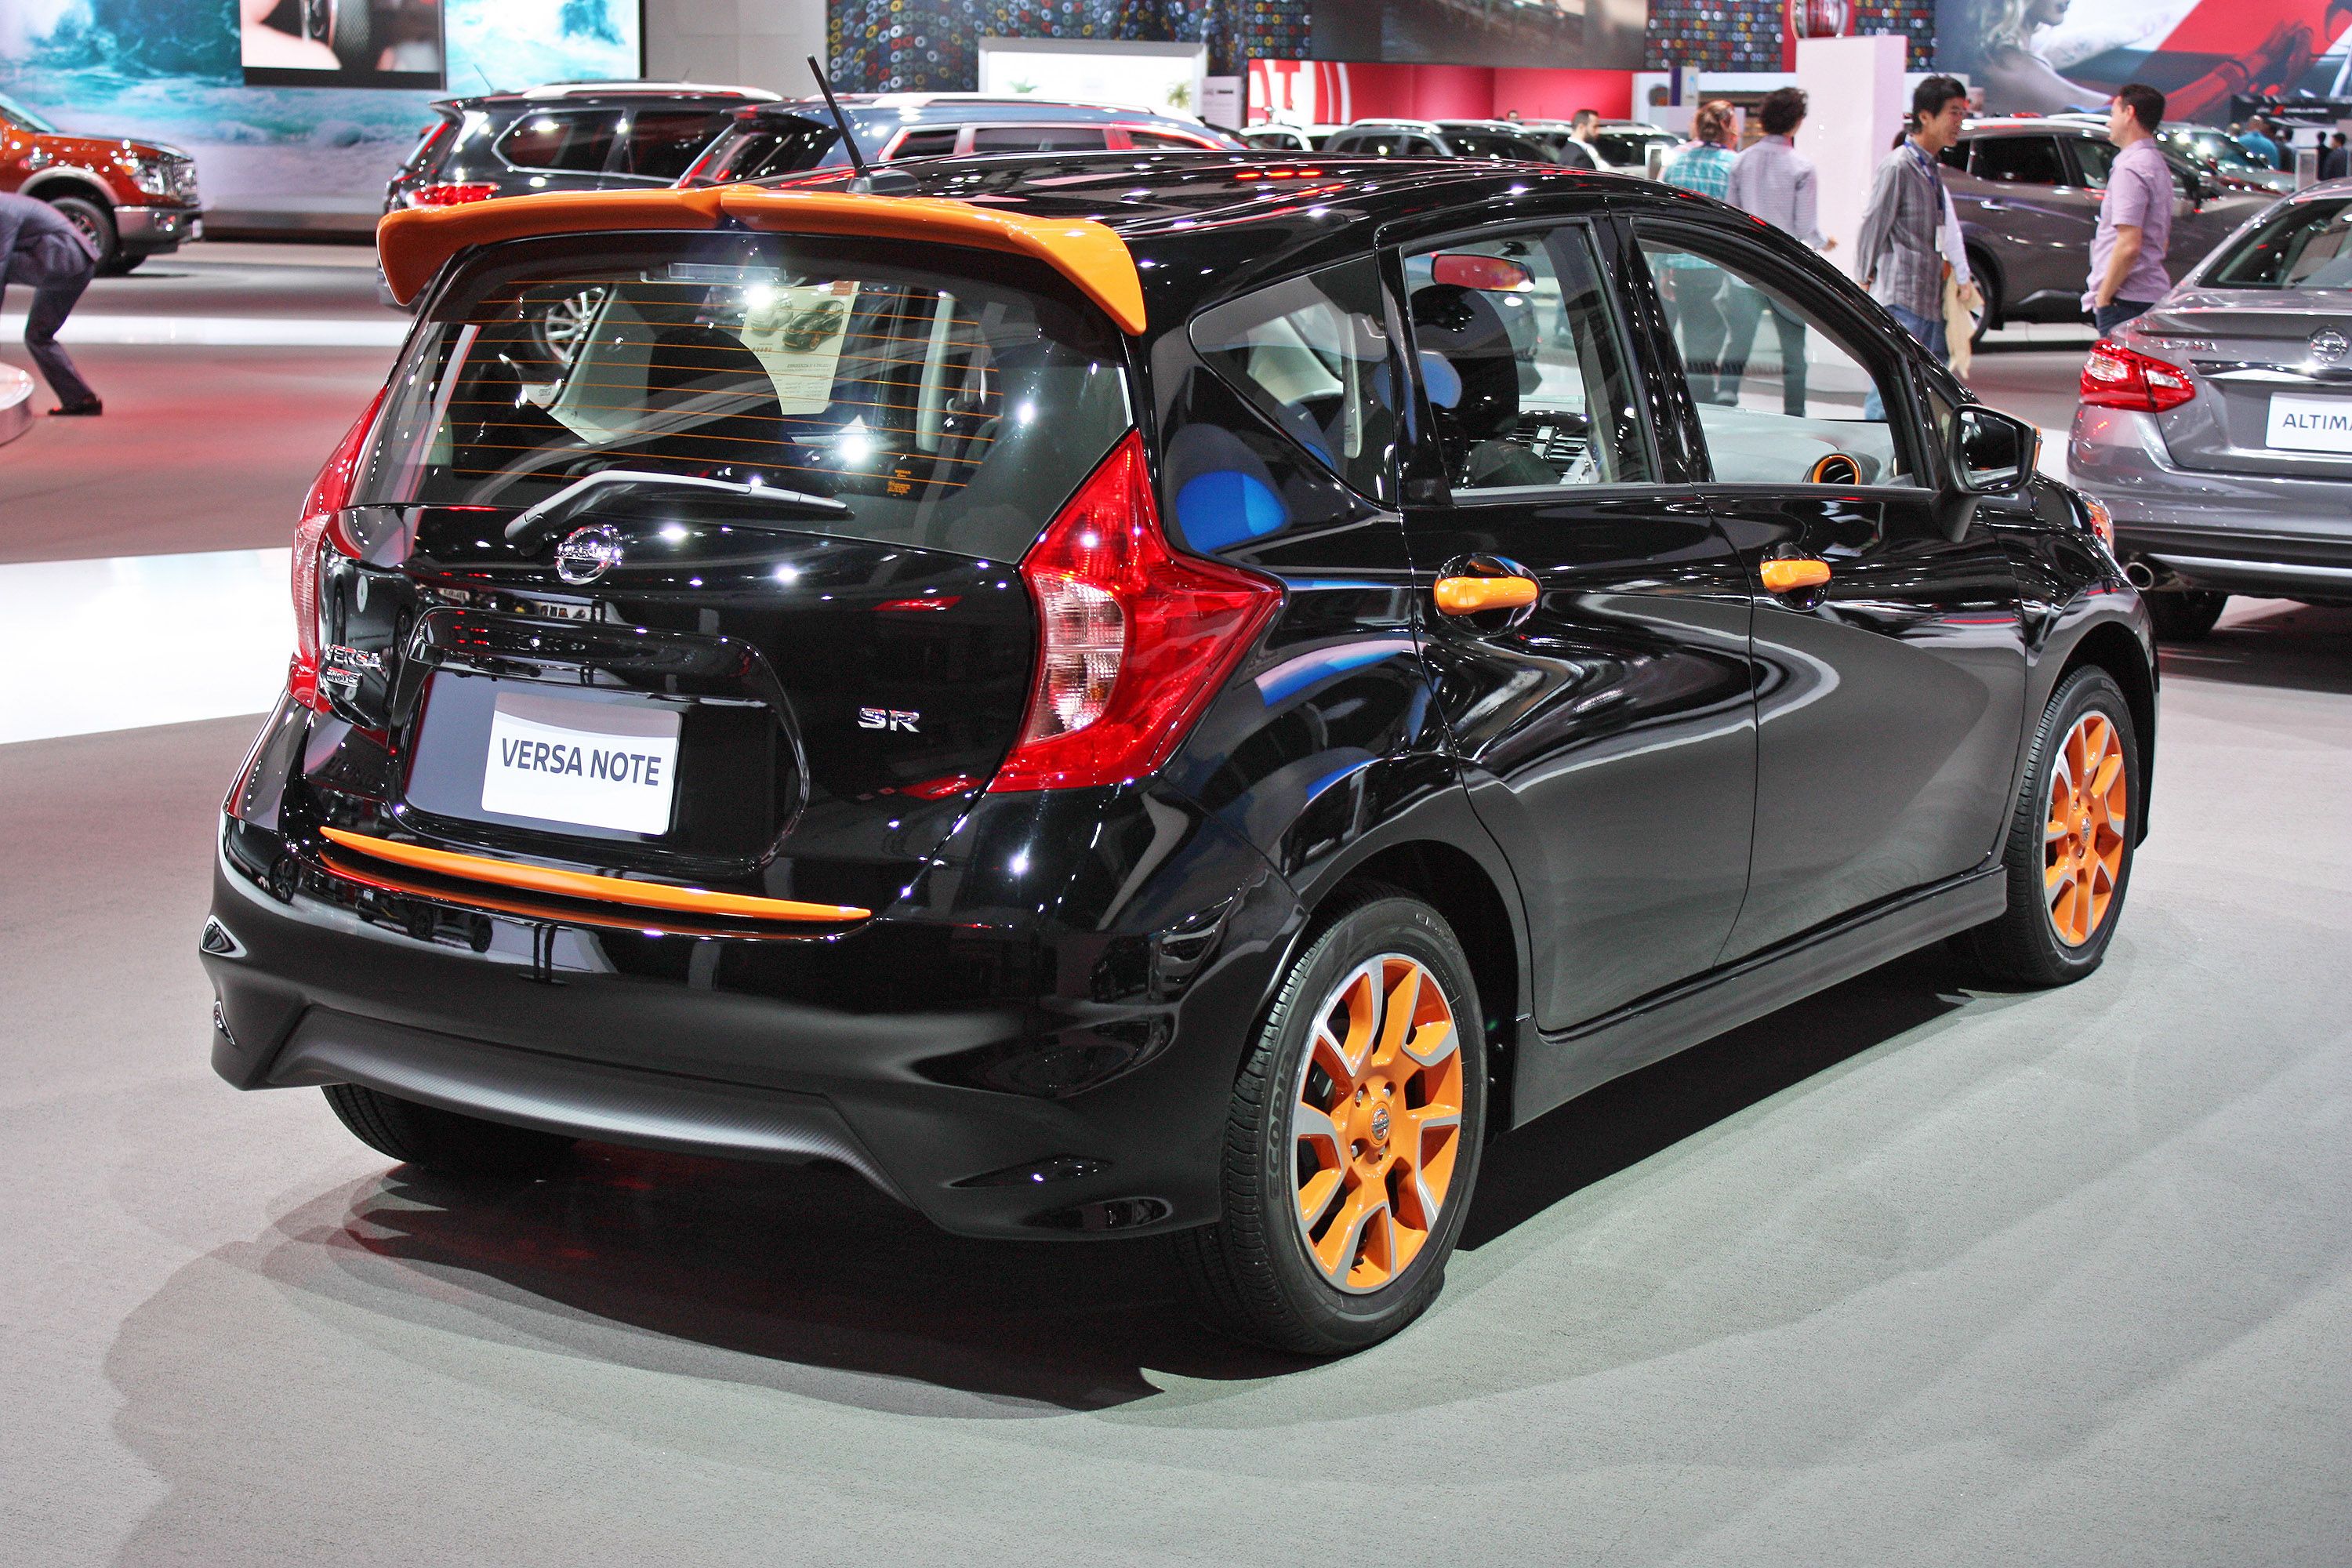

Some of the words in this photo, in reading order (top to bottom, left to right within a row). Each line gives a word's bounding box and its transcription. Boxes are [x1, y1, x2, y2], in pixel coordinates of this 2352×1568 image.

[2282, 413, 2352, 431] ALTIM
[325, 644, 382, 667] VERSA
[328, 667, 361, 688] NOTE
[858, 707, 920, 733] SR
[502, 738, 583, 776] VERSA
[590, 749, 662, 786] NOTE
